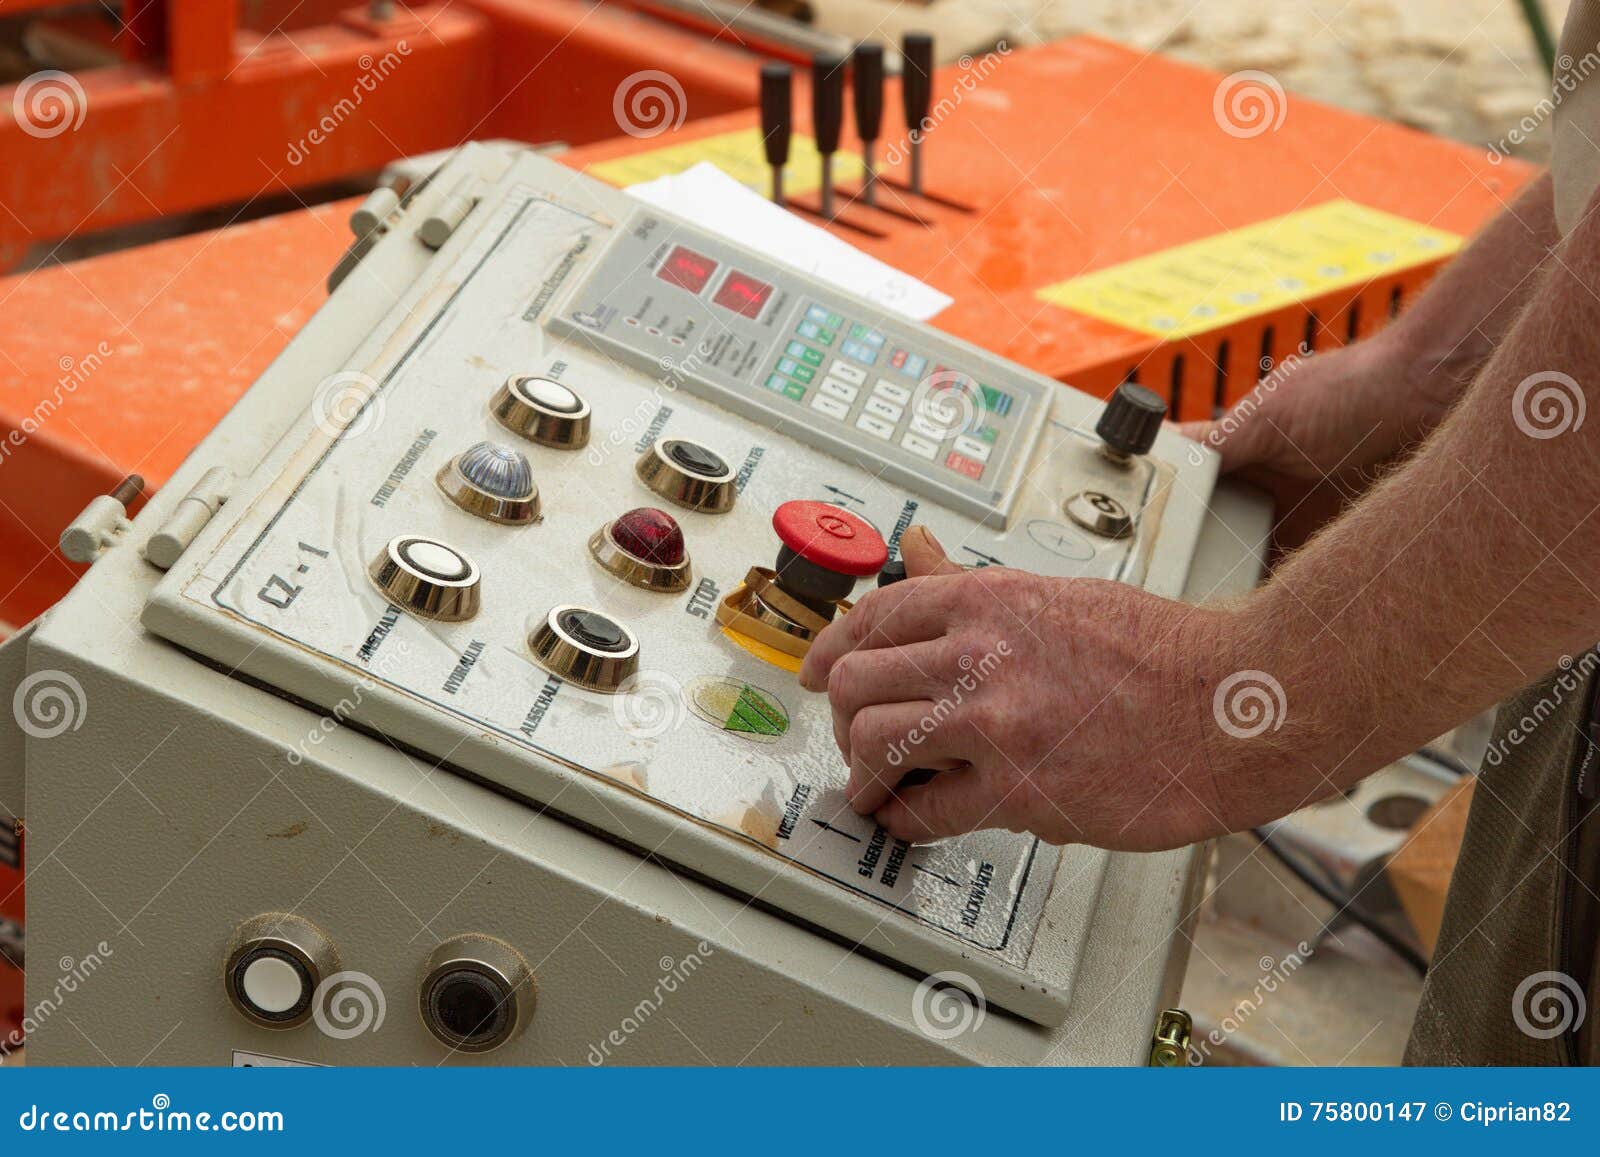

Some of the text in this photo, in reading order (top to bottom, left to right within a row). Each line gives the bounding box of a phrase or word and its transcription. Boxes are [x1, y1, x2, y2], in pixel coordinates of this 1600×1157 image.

[257, 573, 304, 609] CZ
[685, 577, 720, 620] STOP
[441, 639, 486, 695] HYDRAULIK
[519, 673, 563, 738] AUSSCHALT
